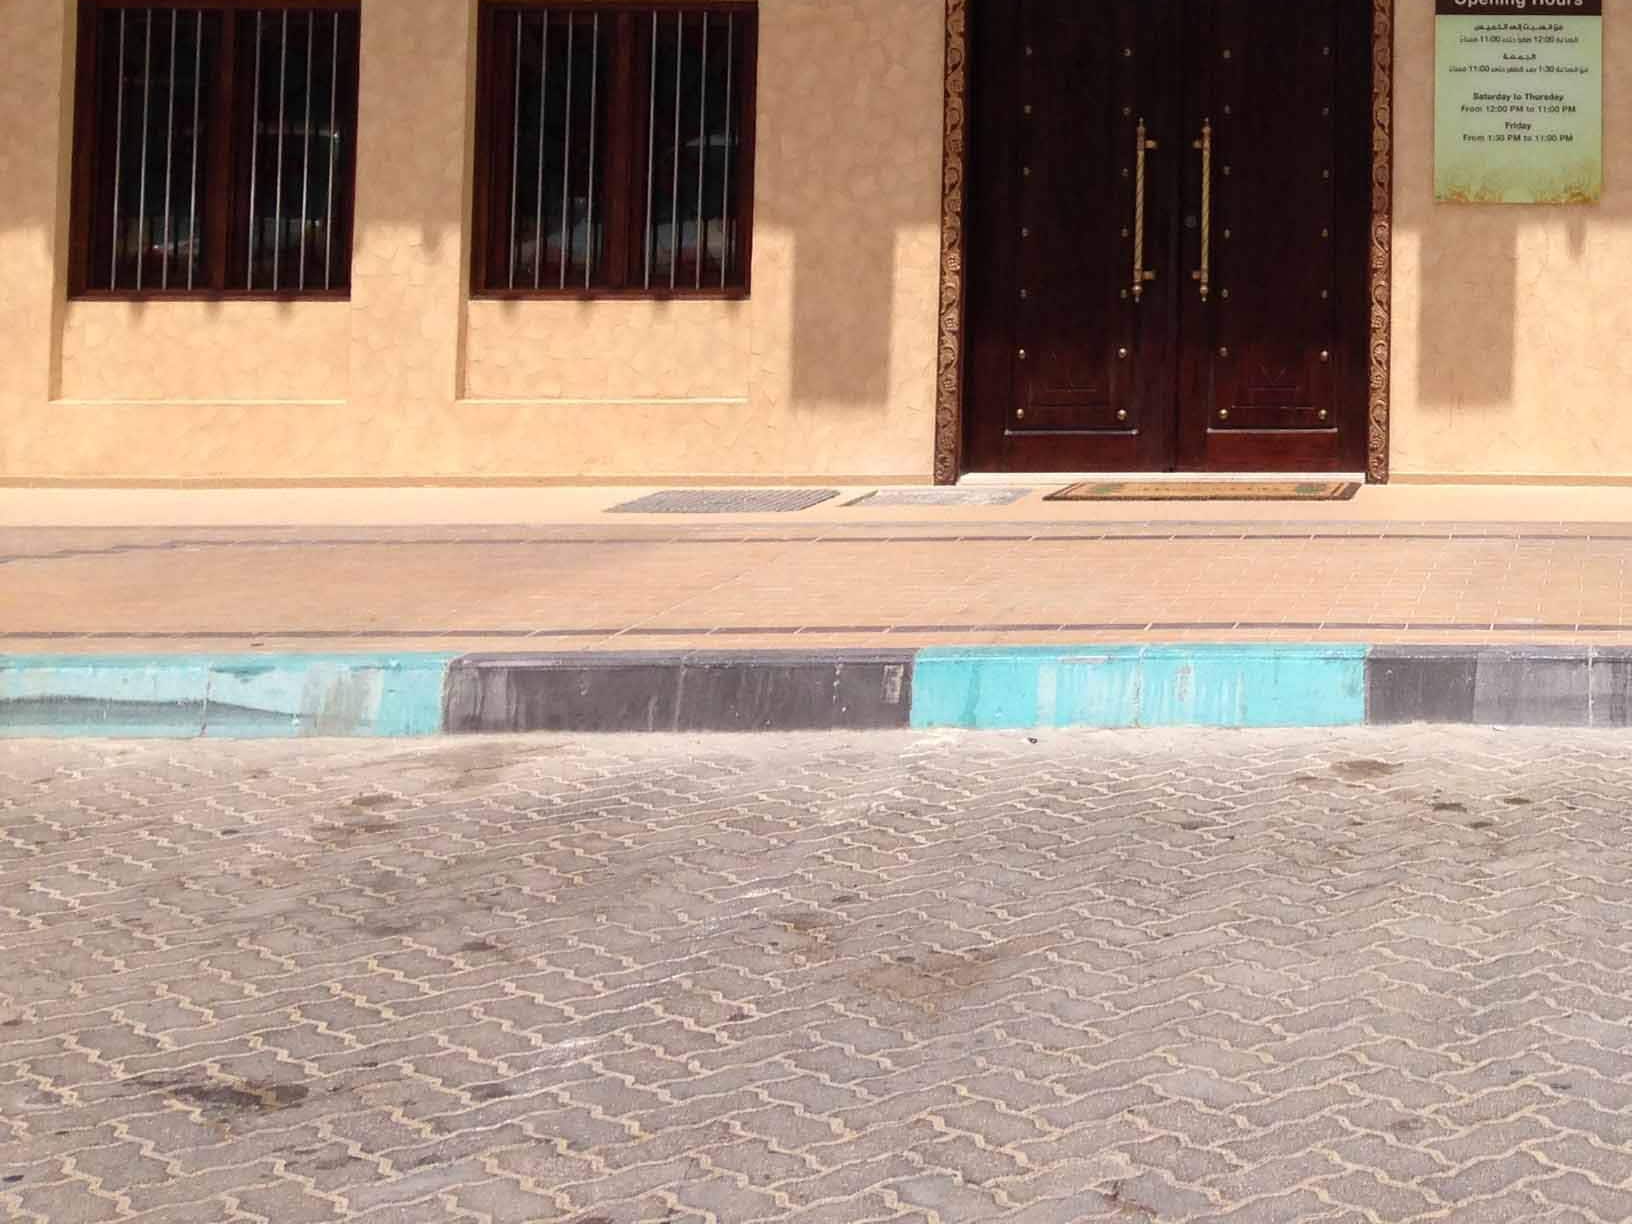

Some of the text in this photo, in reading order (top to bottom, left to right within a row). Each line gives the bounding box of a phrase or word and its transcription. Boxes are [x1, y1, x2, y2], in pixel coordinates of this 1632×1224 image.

[1473, 93, 1511, 102] Saturday
[1525, 93, 1564, 102] Thursday
[1505, 122, 1531, 130] Friday
